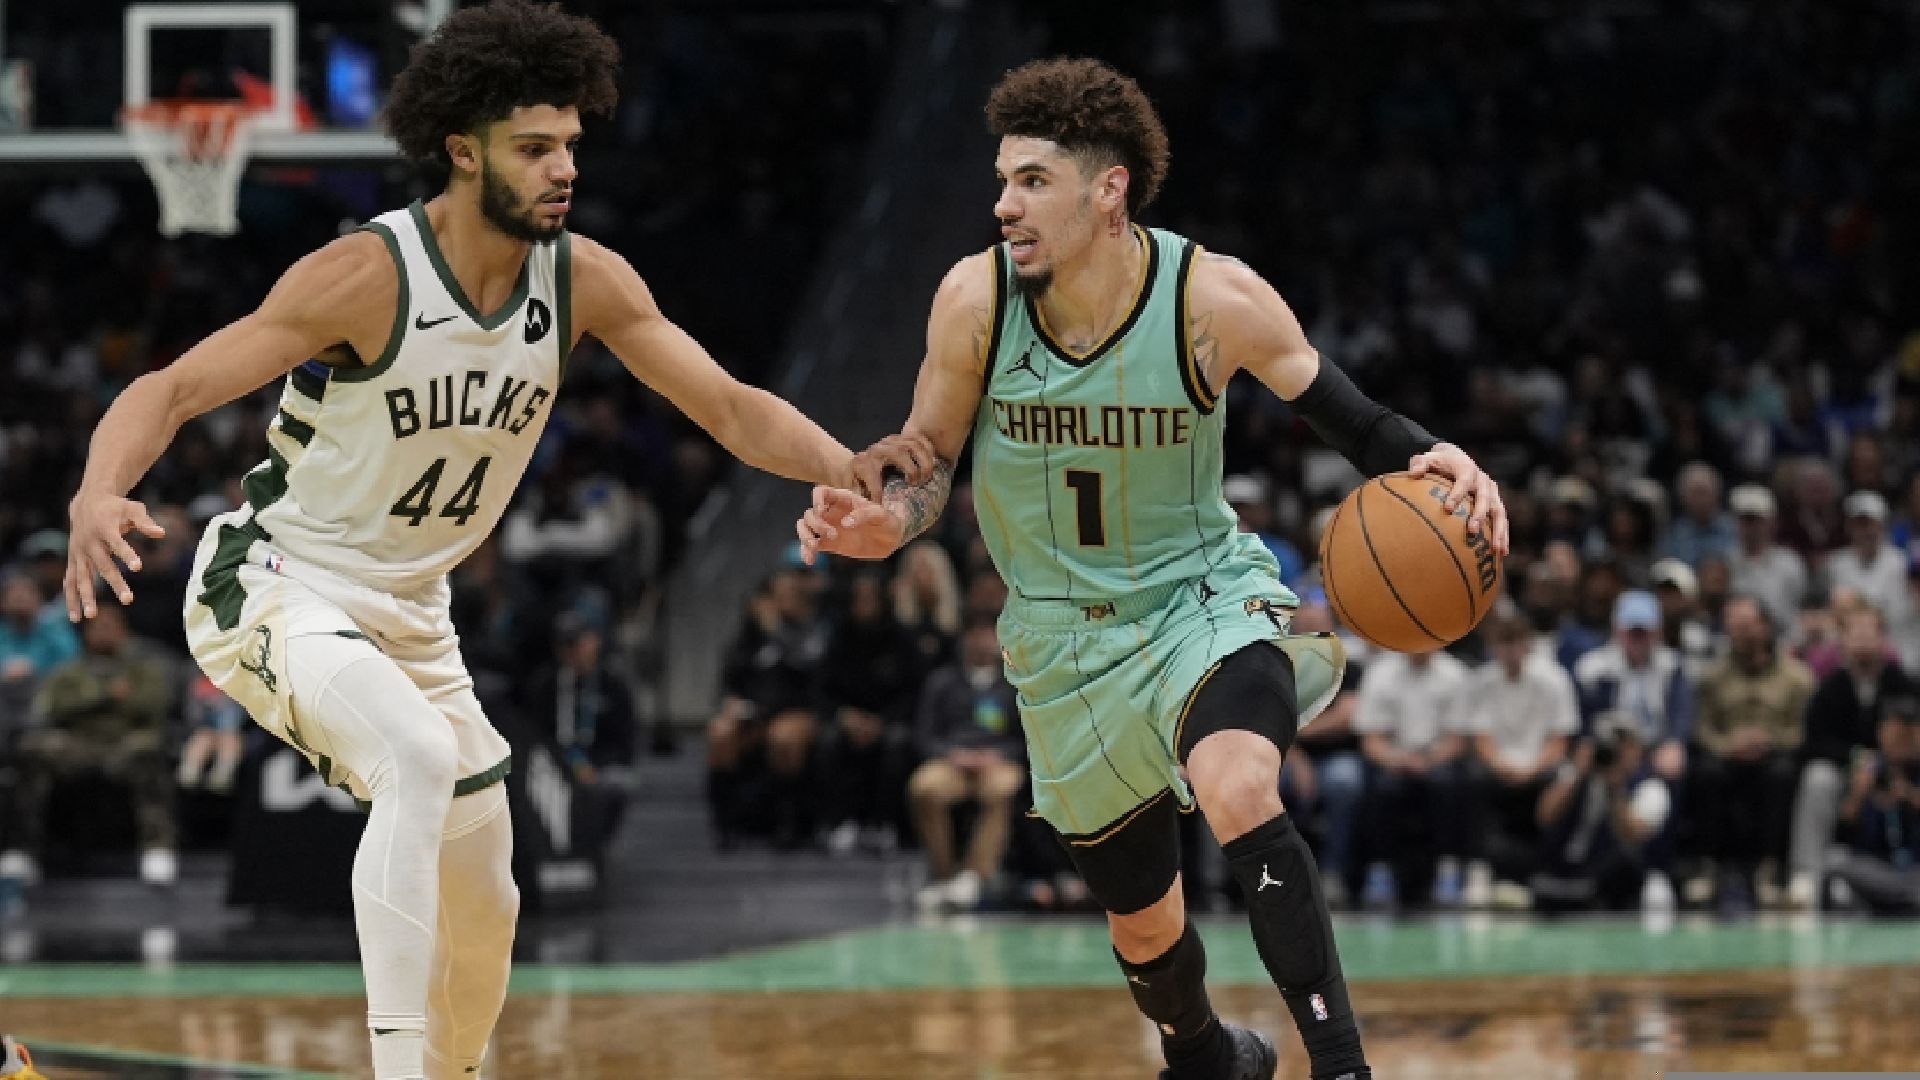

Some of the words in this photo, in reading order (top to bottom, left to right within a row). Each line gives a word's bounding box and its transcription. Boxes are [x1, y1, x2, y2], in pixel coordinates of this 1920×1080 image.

[384, 370, 551, 441] BUCKS
[991, 398, 1190, 449] CHARLOTTE
[388, 456, 492, 527] 44
[1064, 467, 1107, 548] 1
